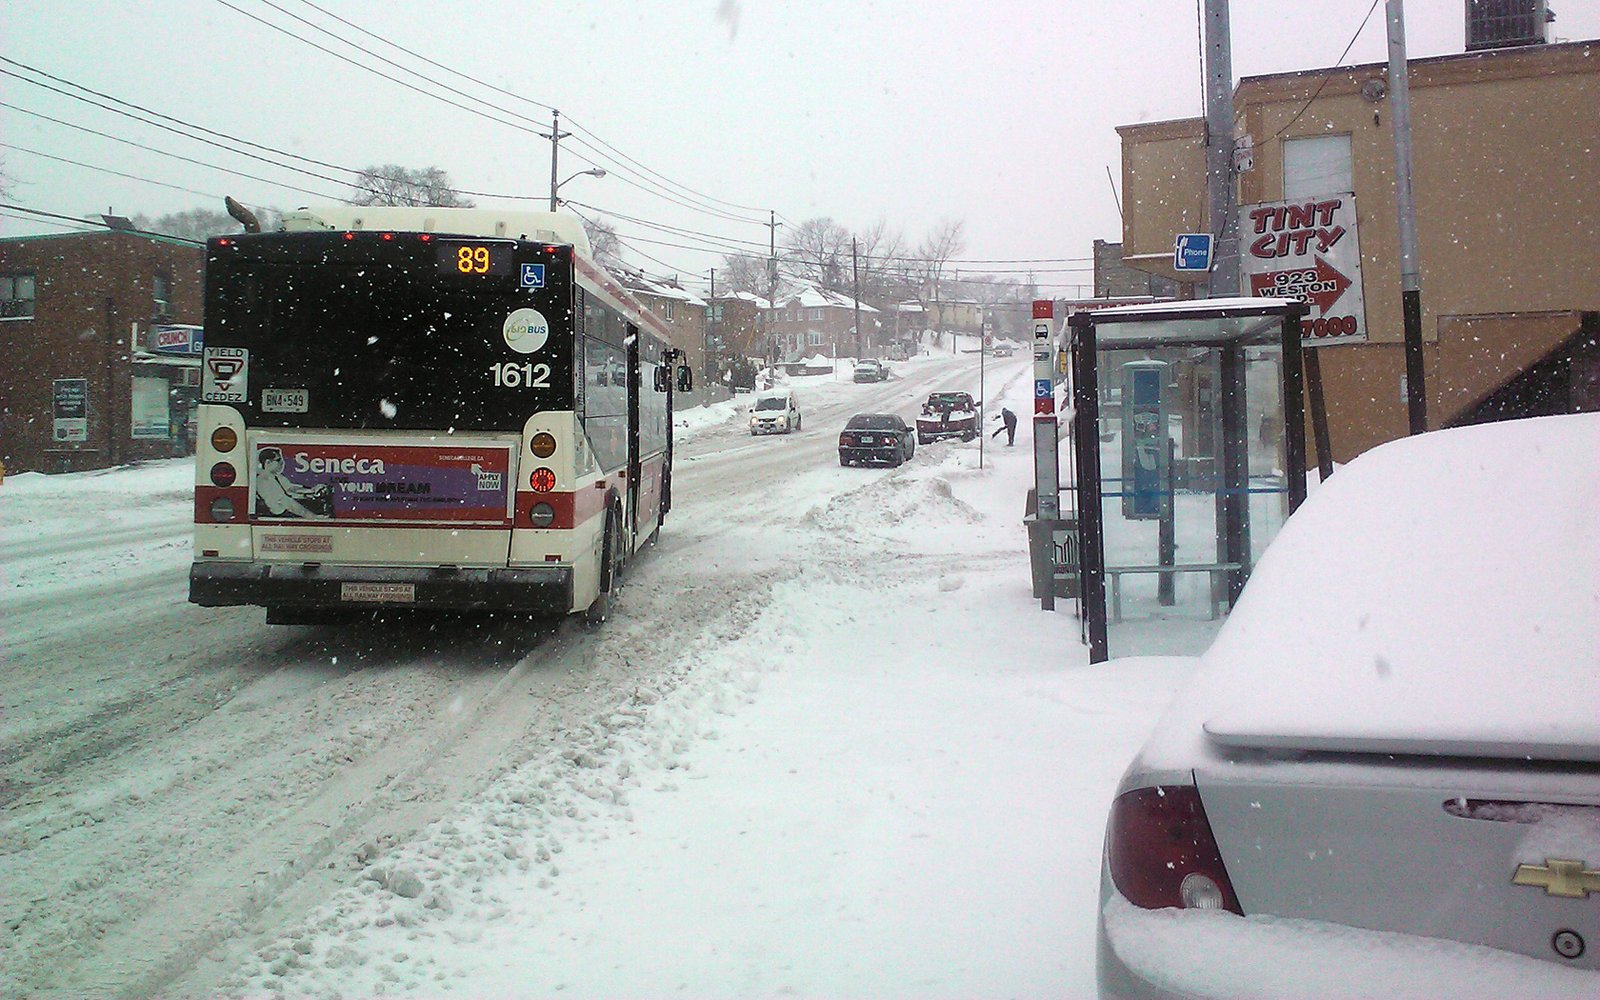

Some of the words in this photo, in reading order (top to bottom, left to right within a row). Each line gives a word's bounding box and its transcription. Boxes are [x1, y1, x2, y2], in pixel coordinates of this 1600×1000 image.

[1249, 200, 1341, 234] TINT
[1249, 225, 1346, 258] CITY
[458, 246, 490, 273] 89
[1275, 271, 1317, 286] 923
[1260, 281, 1336, 298] WESTON
[208, 348, 244, 357] YIELD
[489, 362, 550, 387] 1612
[206, 392, 242, 402] CEDEZ
[294, 452, 385, 474] Seneca
[340, 482, 374, 493] YOUR
[480, 481, 499, 489] NOW
